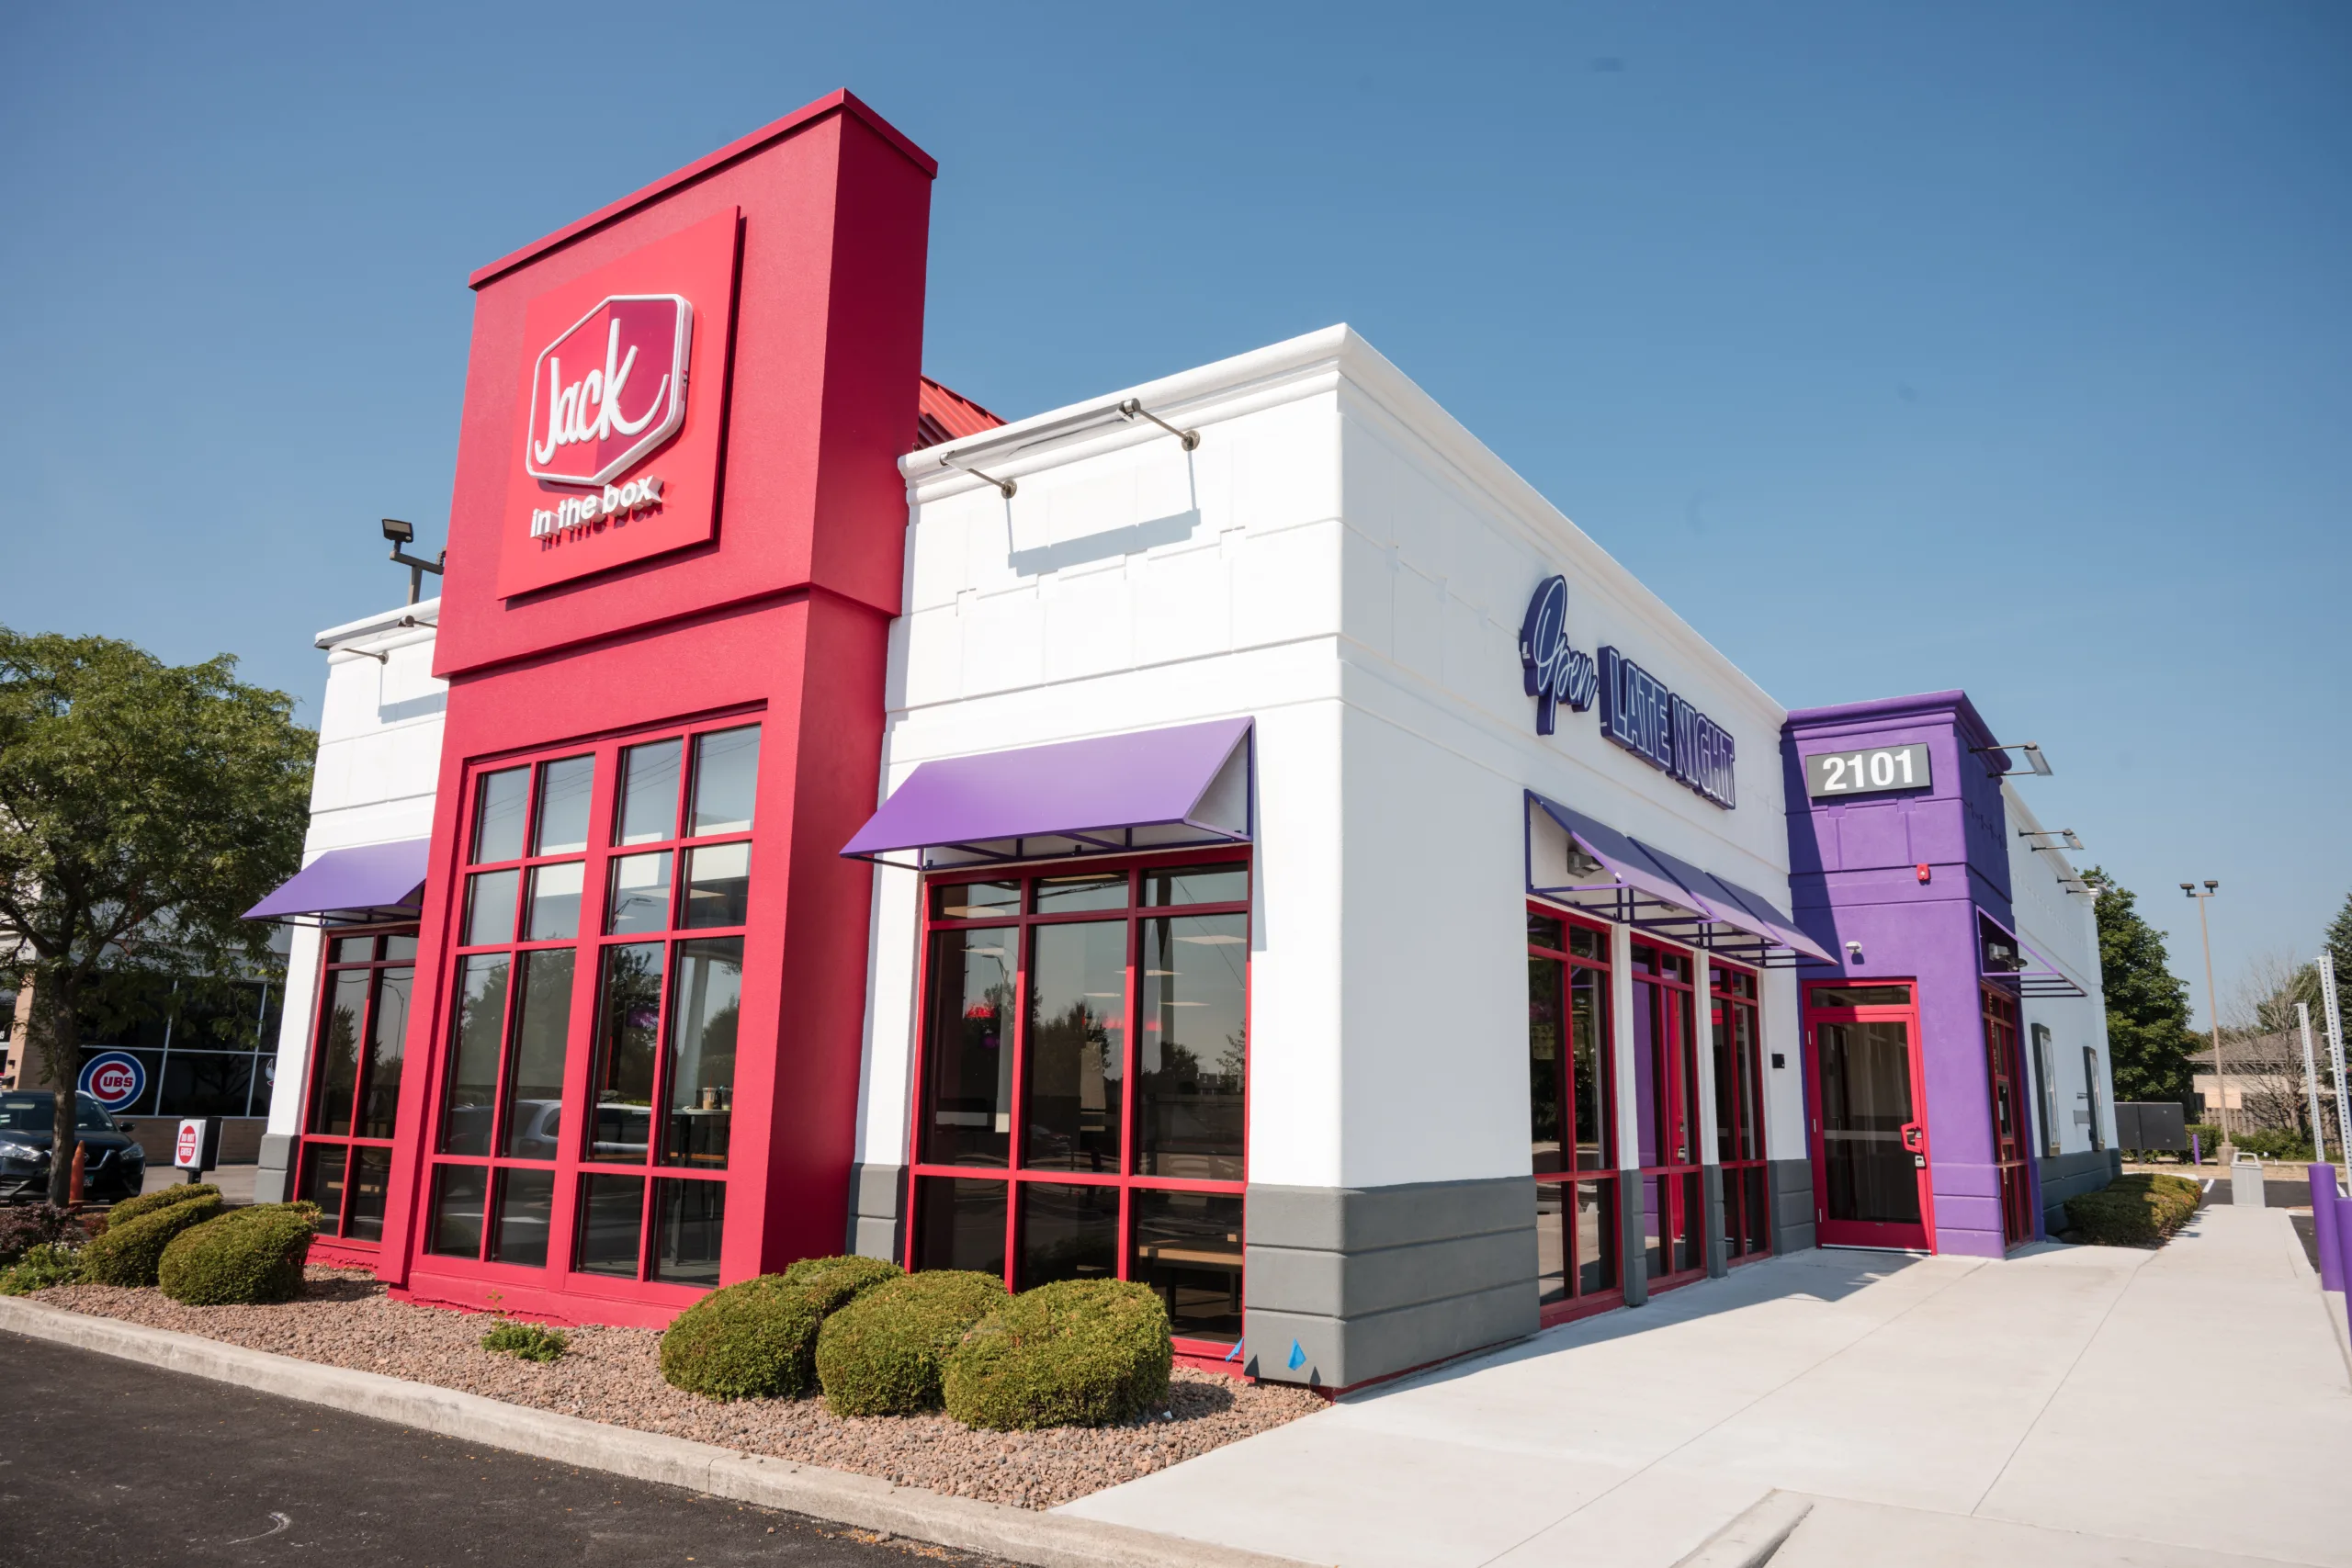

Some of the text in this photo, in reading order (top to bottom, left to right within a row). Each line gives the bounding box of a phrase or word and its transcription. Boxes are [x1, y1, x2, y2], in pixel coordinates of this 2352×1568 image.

[535, 318, 670, 465] Jack
[530, 475, 662, 539] in the box
[1524, 575, 1599, 734] Open
[1605, 646, 1735, 809] LATE NIGHT
[1823, 749, 1914, 791] 2101
[92, 1063, 134, 1101] CUBS
[180, 1147, 192, 1156] ENTER
[181, 1133, 187, 1142] DO
